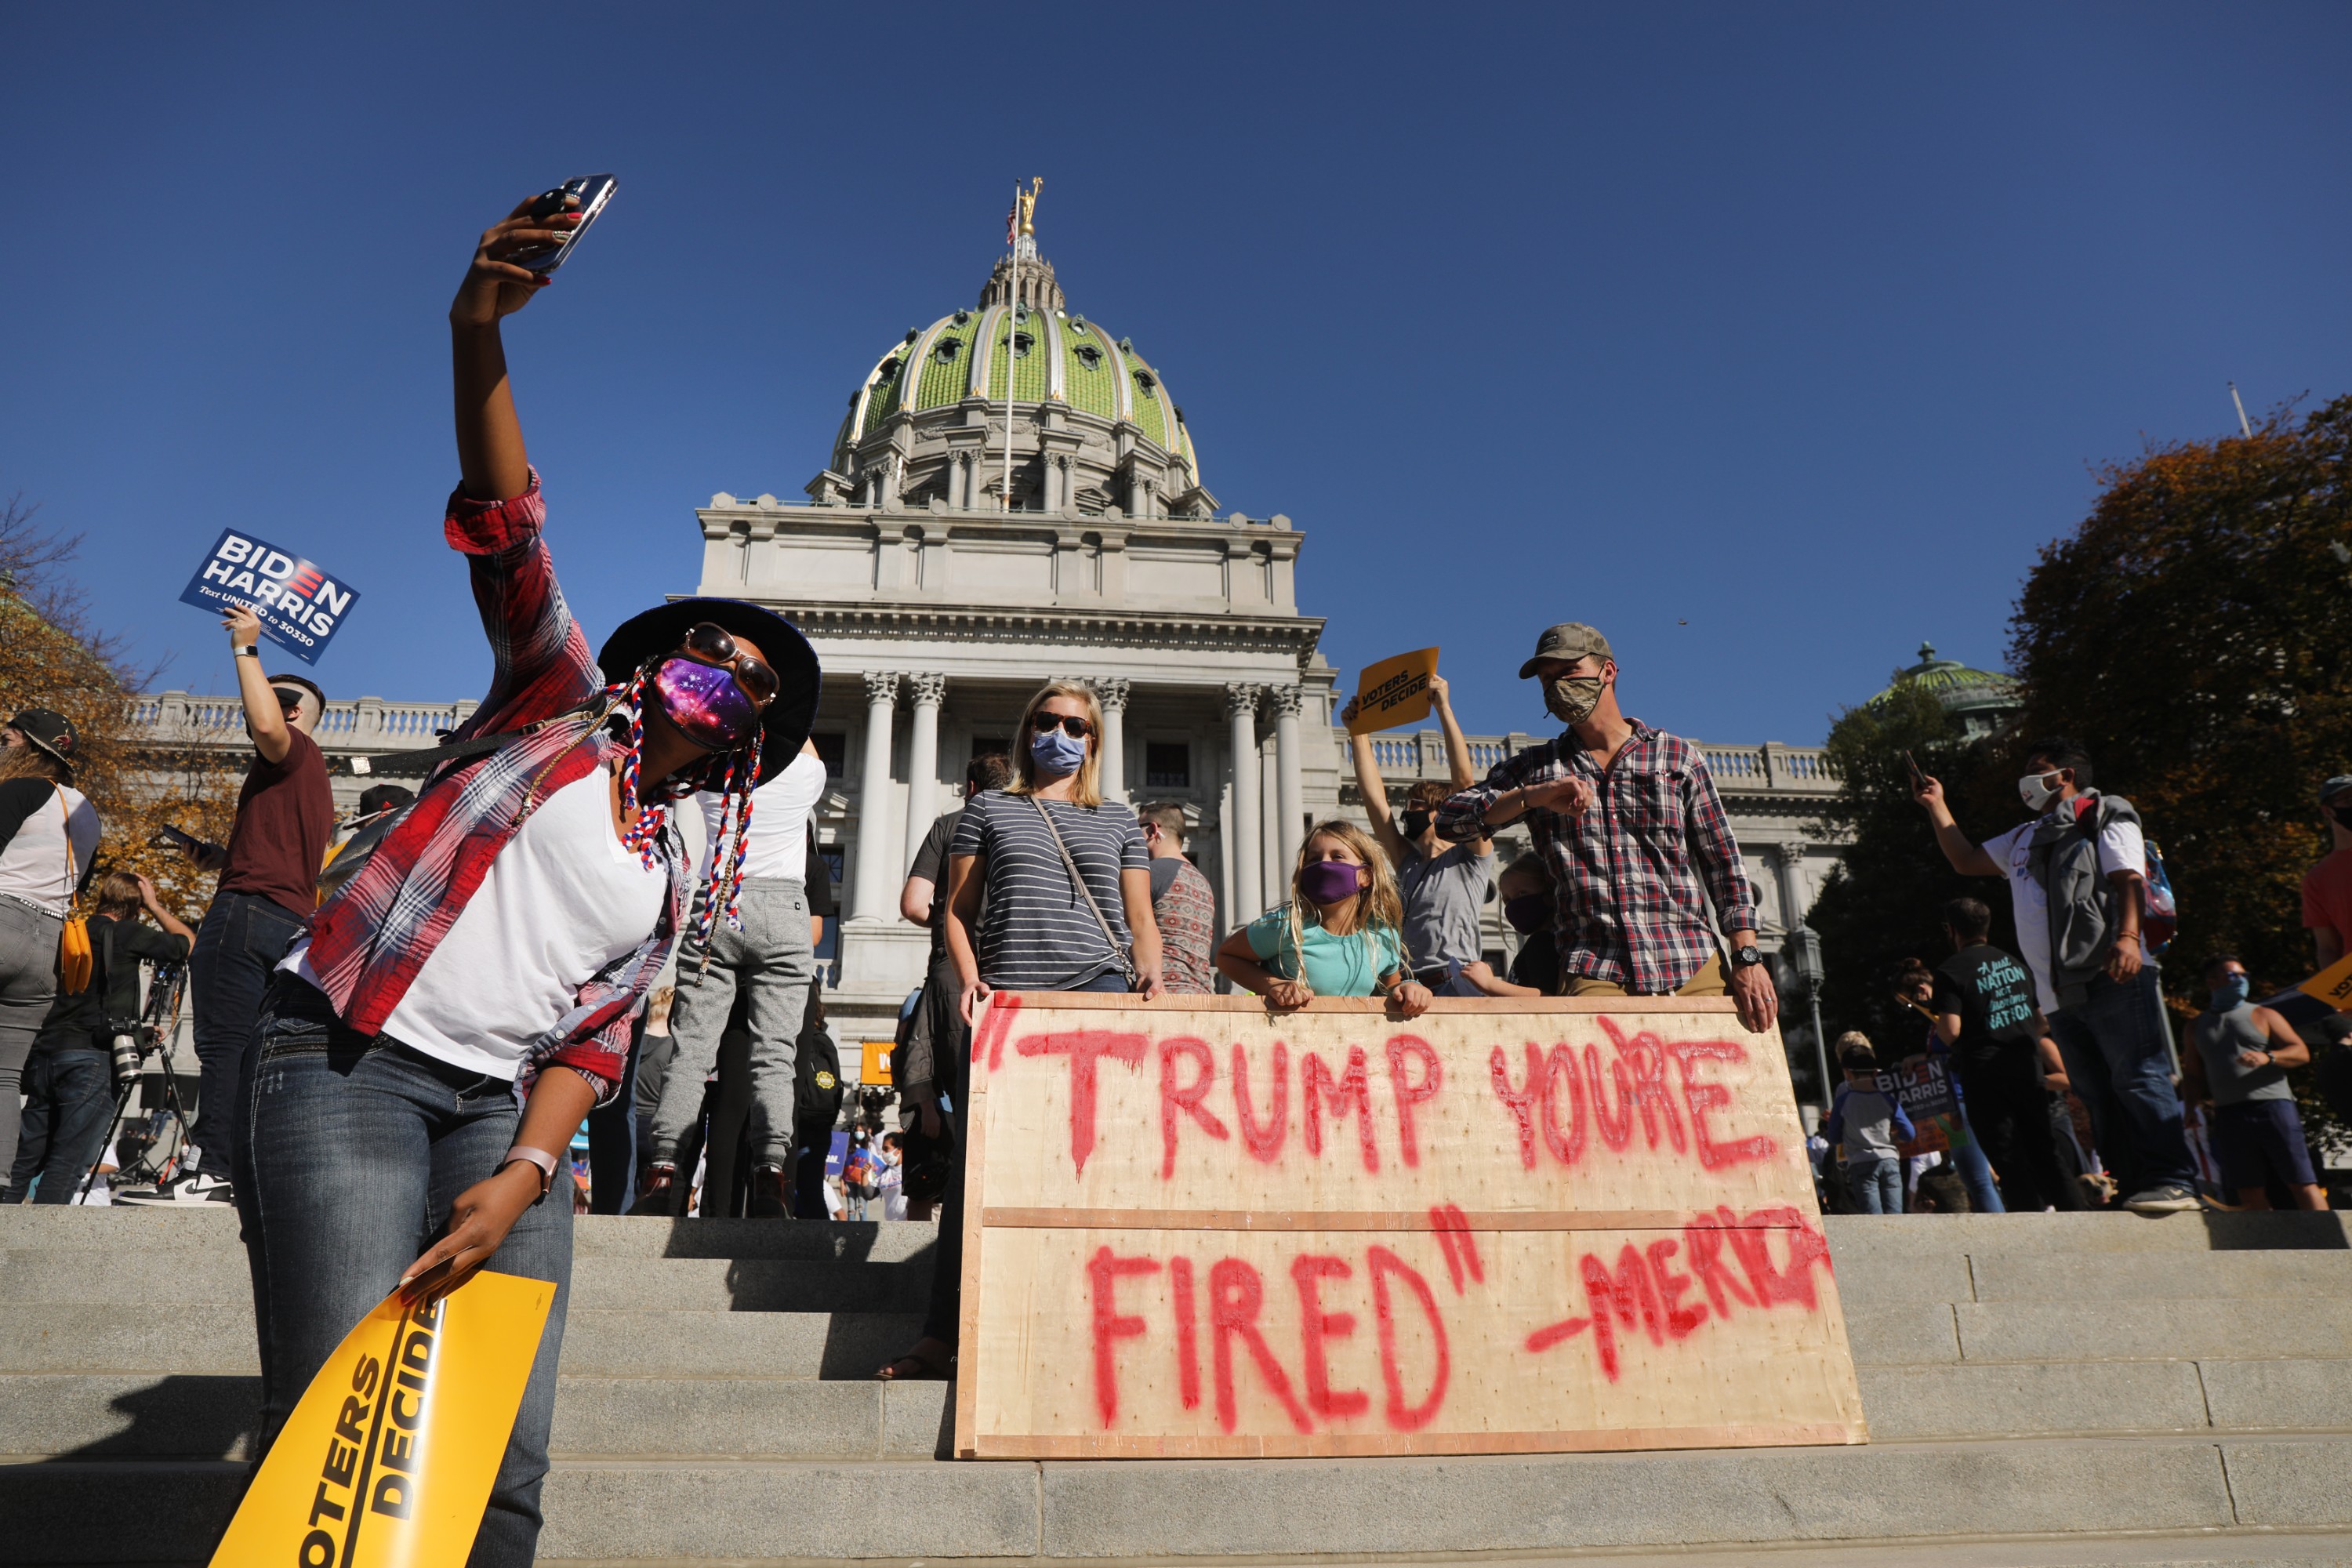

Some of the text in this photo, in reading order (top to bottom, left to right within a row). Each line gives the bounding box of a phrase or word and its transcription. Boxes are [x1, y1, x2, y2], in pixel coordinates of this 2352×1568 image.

[216, 535, 351, 617] BIDEN
[202, 559, 334, 637] HARRIS
[198, 585, 221, 598] Text
[221, 593, 268, 617] UNITED
[267, 615, 278, 624] to
[278, 620, 314, 647] 30330
[1362, 670, 1409, 705] VOTERS
[1381, 677, 1427, 712] DECIDE
[1976, 966, 2026, 994] NATION
[1977, 961, 1991, 975] A
[1994, 985, 2013, 998] NOT
[1875, 1060, 1944, 1092] BIDEN
[370, 1295, 448, 1520] DECIDE
[299, 1352, 380, 1568] OTERS
